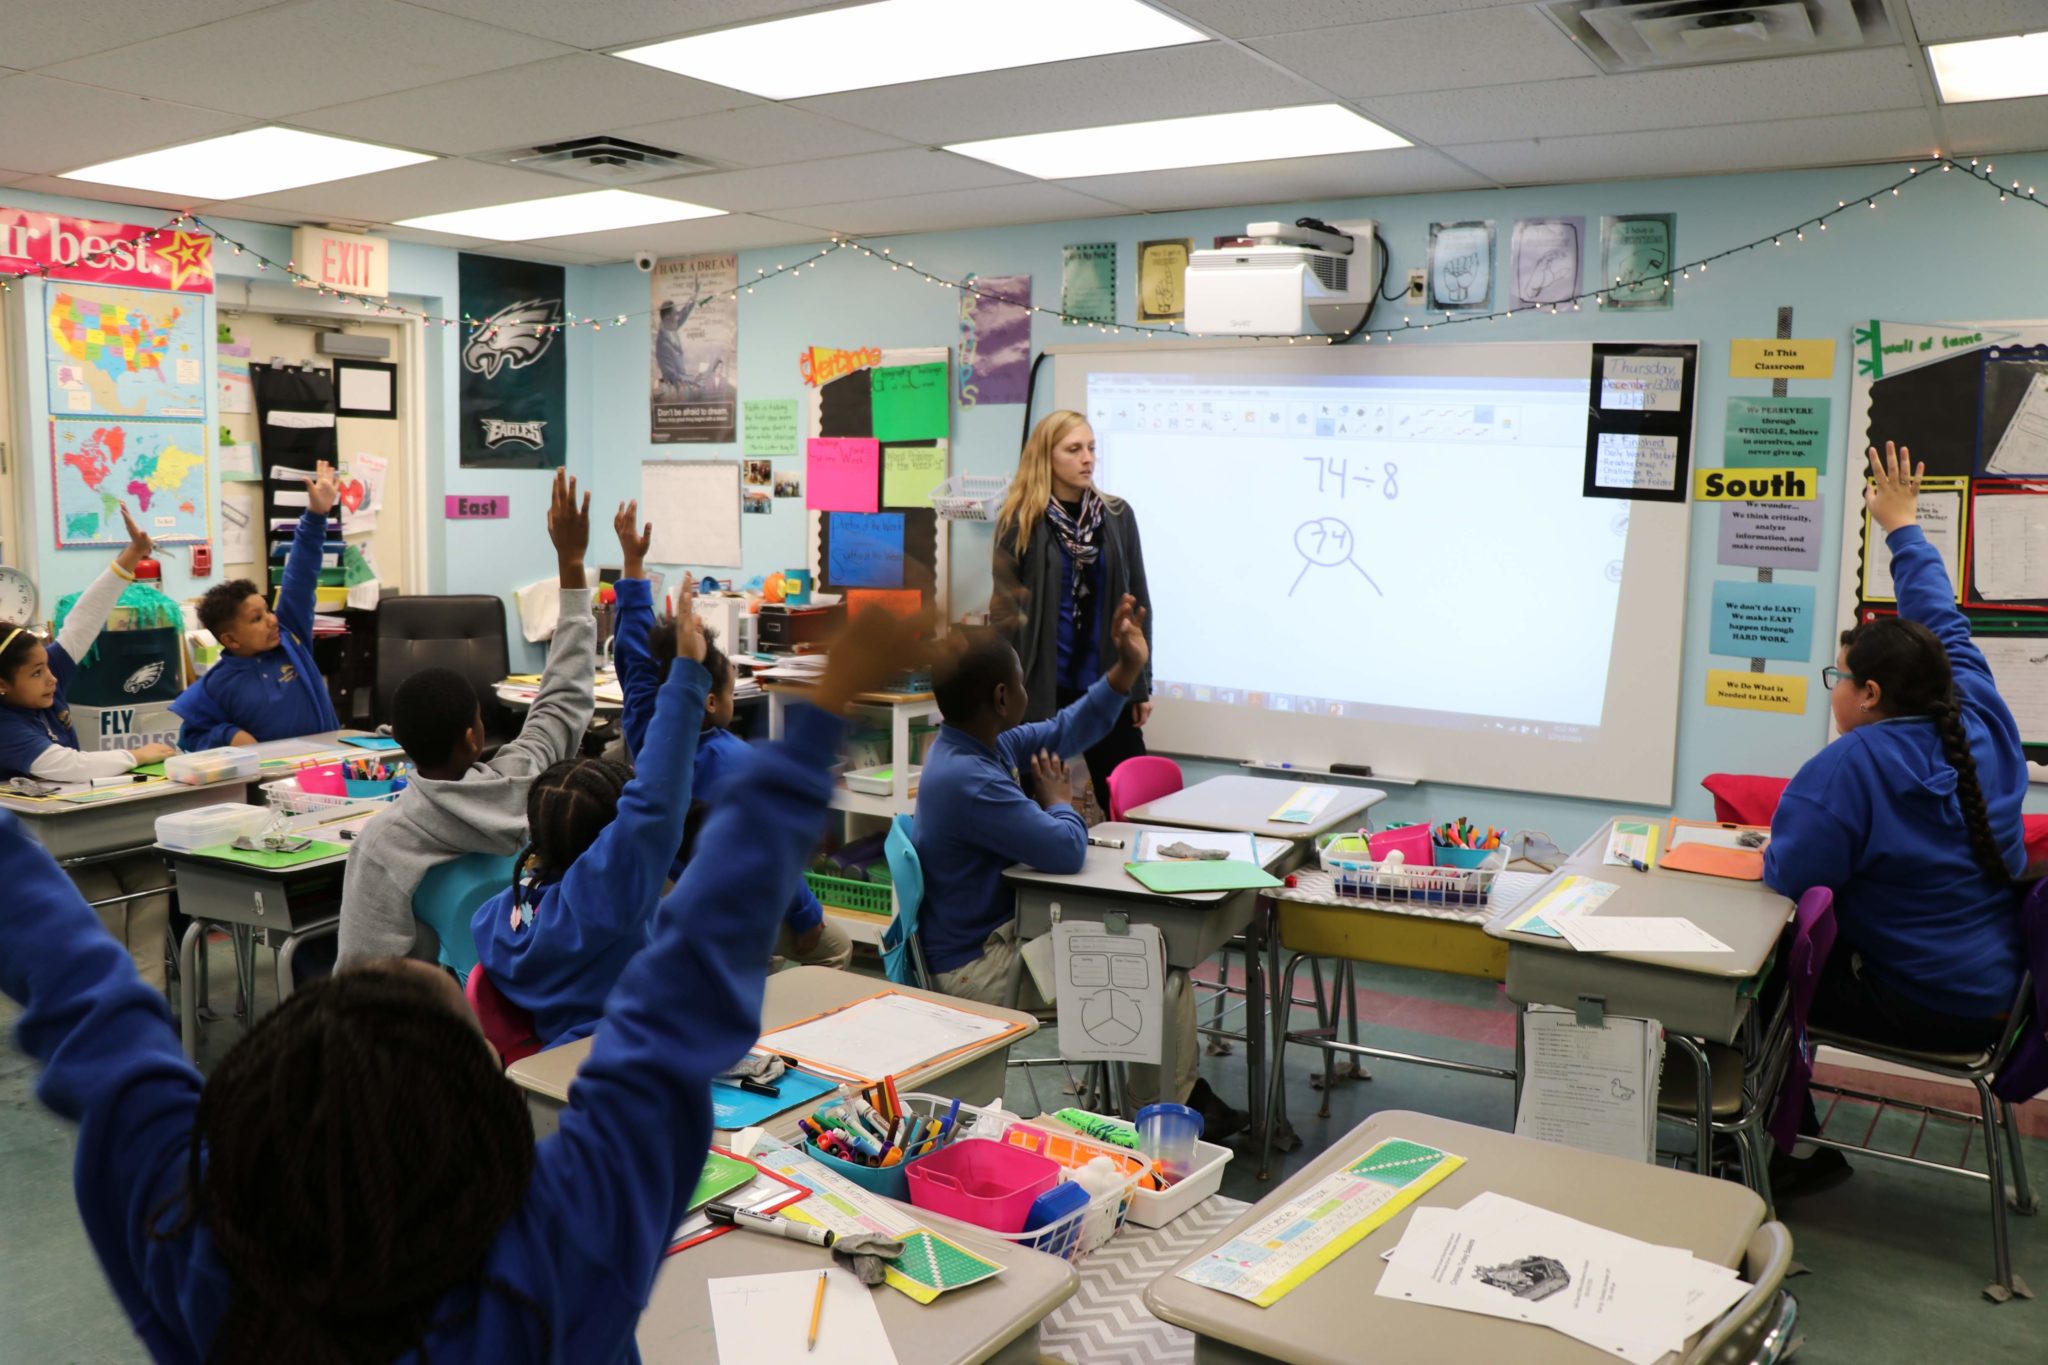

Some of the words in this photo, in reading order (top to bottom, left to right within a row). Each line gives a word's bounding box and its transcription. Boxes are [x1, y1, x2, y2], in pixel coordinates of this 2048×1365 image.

[46, 217, 160, 274] best.
[322, 239, 374, 288] EXIT
[660, 262, 687, 274] HAVE
[688, 262, 696, 272] A
[697, 258, 735, 271] DREAM
[1763, 349, 1774, 357] In
[1776, 349, 1797, 357] This
[1754, 362, 1804, 371] Classroom
[674, 408, 682, 416] be
[1746, 406, 1759, 414] We
[1761, 406, 1814, 415] PERSEVERE
[1762, 417, 1796, 426] through
[483, 419, 546, 449] EAGLES
[1738, 427, 1788, 436] STRUGGLE,
[1789, 428, 1819, 436] believe
[1743, 438, 1751, 446] in
[1753, 438, 1795, 447] ourselves,
[1796, 439, 1812, 447] and
[1772, 448, 1790, 457] give
[1705, 471, 1806, 497] South
[459, 498, 497, 516] East
[1746, 500, 1759, 509] We
[1732, 511, 1745, 519] We
[1746, 512, 1770, 520] think
[1771, 513, 1812, 523] critically,
[1755, 523, 1786, 532] analyze
[1312, 529, 1346, 554] 74
[1735, 533, 1787, 542] information,
[1789, 535, 1805, 543] and
[1755, 544, 1807, 553] connections.
[18, 584, 25, 593] 2
[22, 596, 28, 604] 3
[1726, 602, 1739, 610] We
[1740, 603, 1761, 611] don't
[1745, 614, 1768, 622] make
[1729, 623, 1759, 633] happen
[1760, 625, 1794, 634] through
[1732, 633, 1758, 641] HARD
[1759, 635, 1789, 644] WORK.
[1727, 681, 1739, 689] We
[1741, 682, 1752, 690] Do
[1753, 683, 1775, 691] What
[1718, 691, 1748, 699] Needed
[1748, 693, 1757, 701] to
[1759, 695, 1791, 703] LEARN.
[101, 709, 134, 736] FLY
